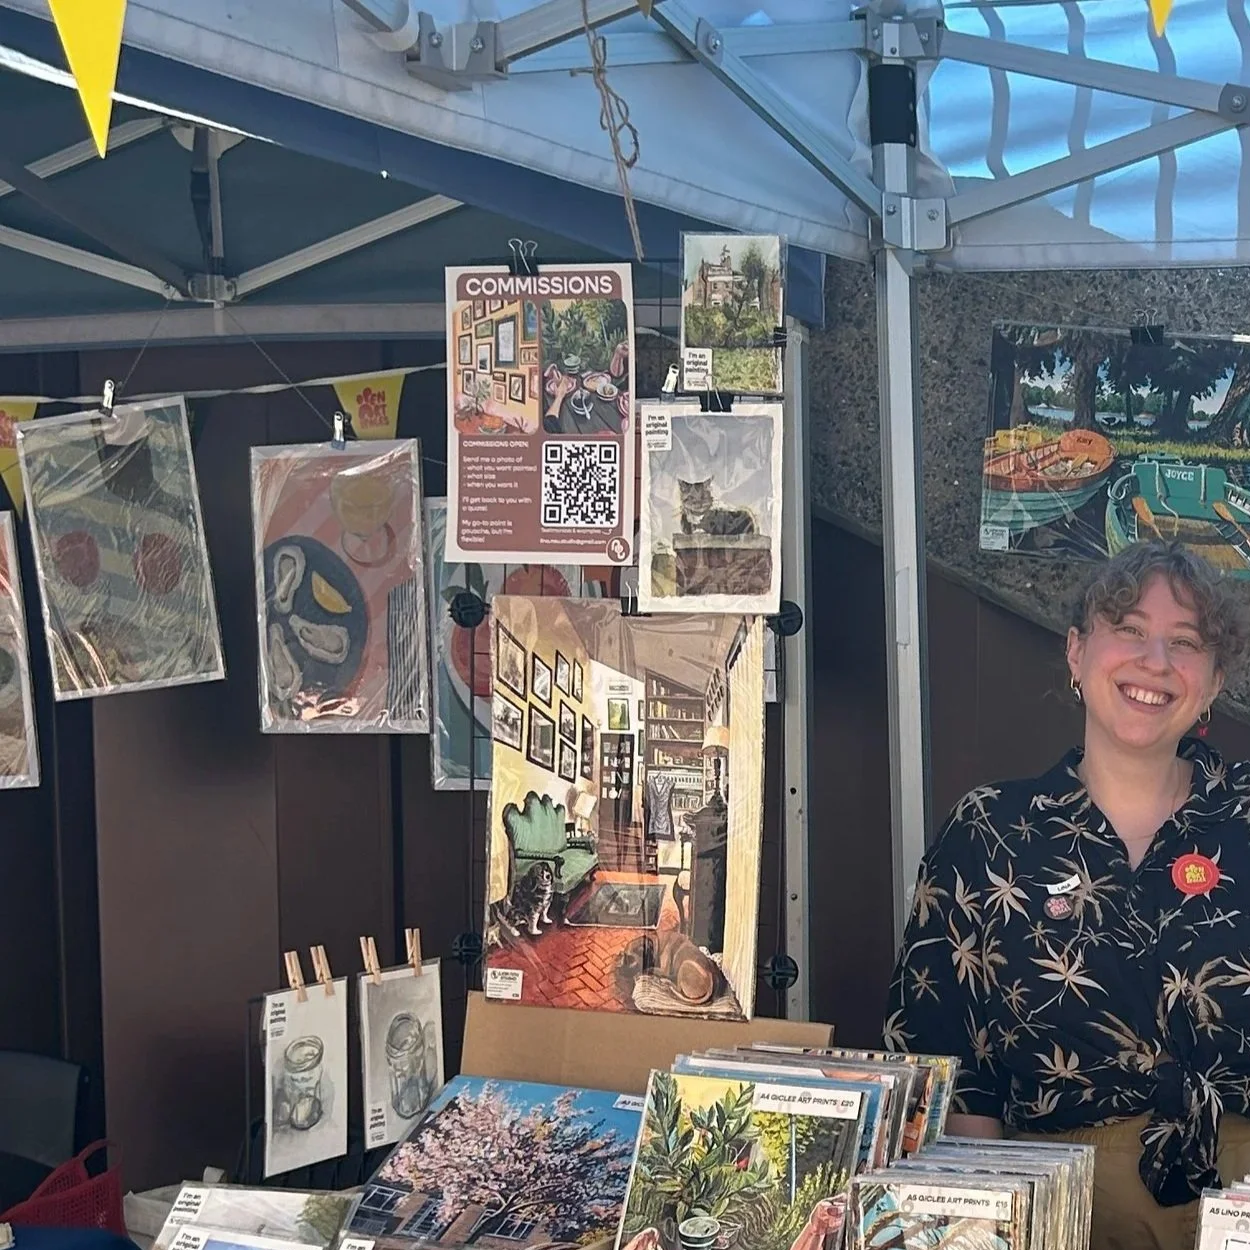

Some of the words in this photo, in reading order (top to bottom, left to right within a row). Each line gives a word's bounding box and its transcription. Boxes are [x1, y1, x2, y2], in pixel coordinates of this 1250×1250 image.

[465, 275, 613, 296] COMMISSIONS
[462, 440, 509, 448] COMMISSIONS
[496, 456, 515, 464] photo
[1164, 467, 1195, 482] JOYCE
[760, 1092, 770, 1100] A4
[771, 1094, 796, 1103] GICLEE
[797, 1096, 812, 1104] ART
[813, 1097, 838, 1106] PRINTS
[841, 1098, 854, 1107] £20
[918, 1195, 945, 1204] GICLEE
[963, 1198, 990, 1207] PRINTS
[1221, 1208, 1239, 1218] LINO
